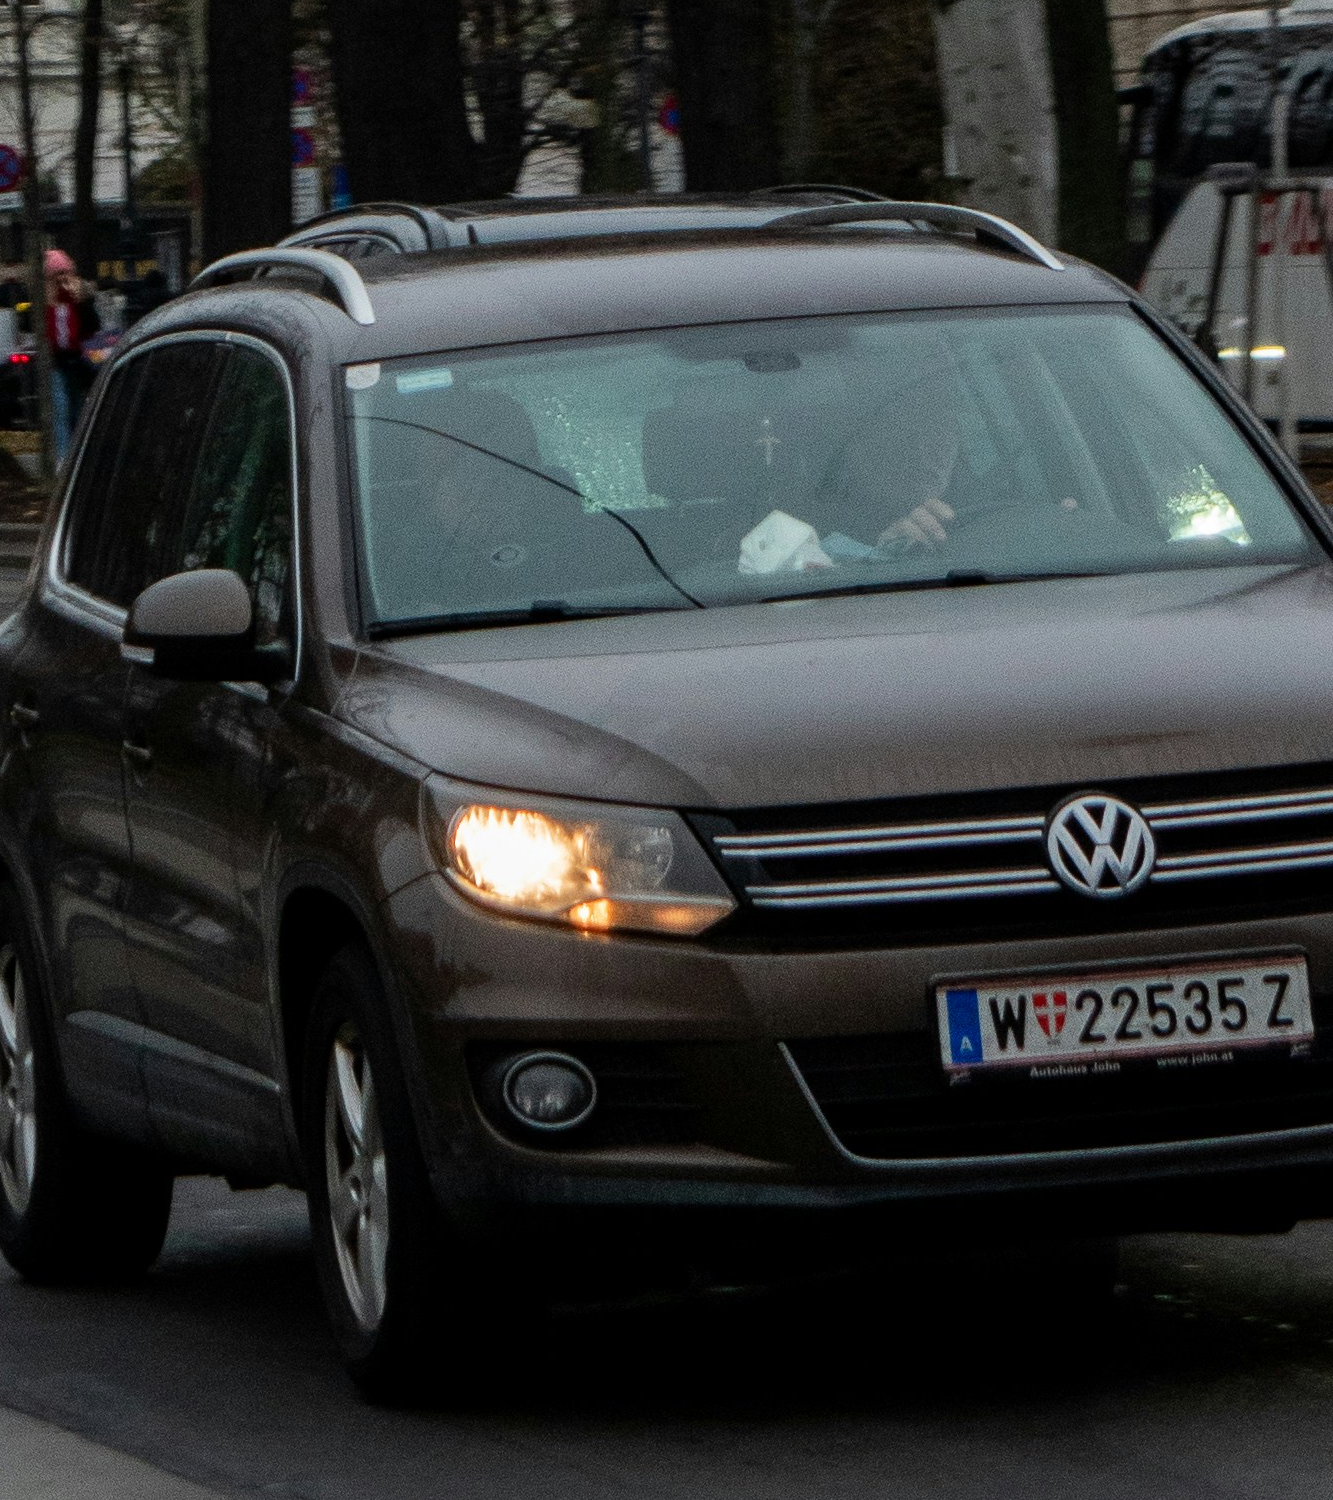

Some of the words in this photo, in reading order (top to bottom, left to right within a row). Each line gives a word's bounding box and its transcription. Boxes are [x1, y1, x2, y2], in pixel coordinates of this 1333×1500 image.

[988, 994, 1028, 1052] W
[959, 1036, 973, 1053] A
[1030, 1063, 1088, 1078] Autohaus
[1092, 1060, 1121, 1073] John
[1156, 1051, 1234, 1069] www.john.at
